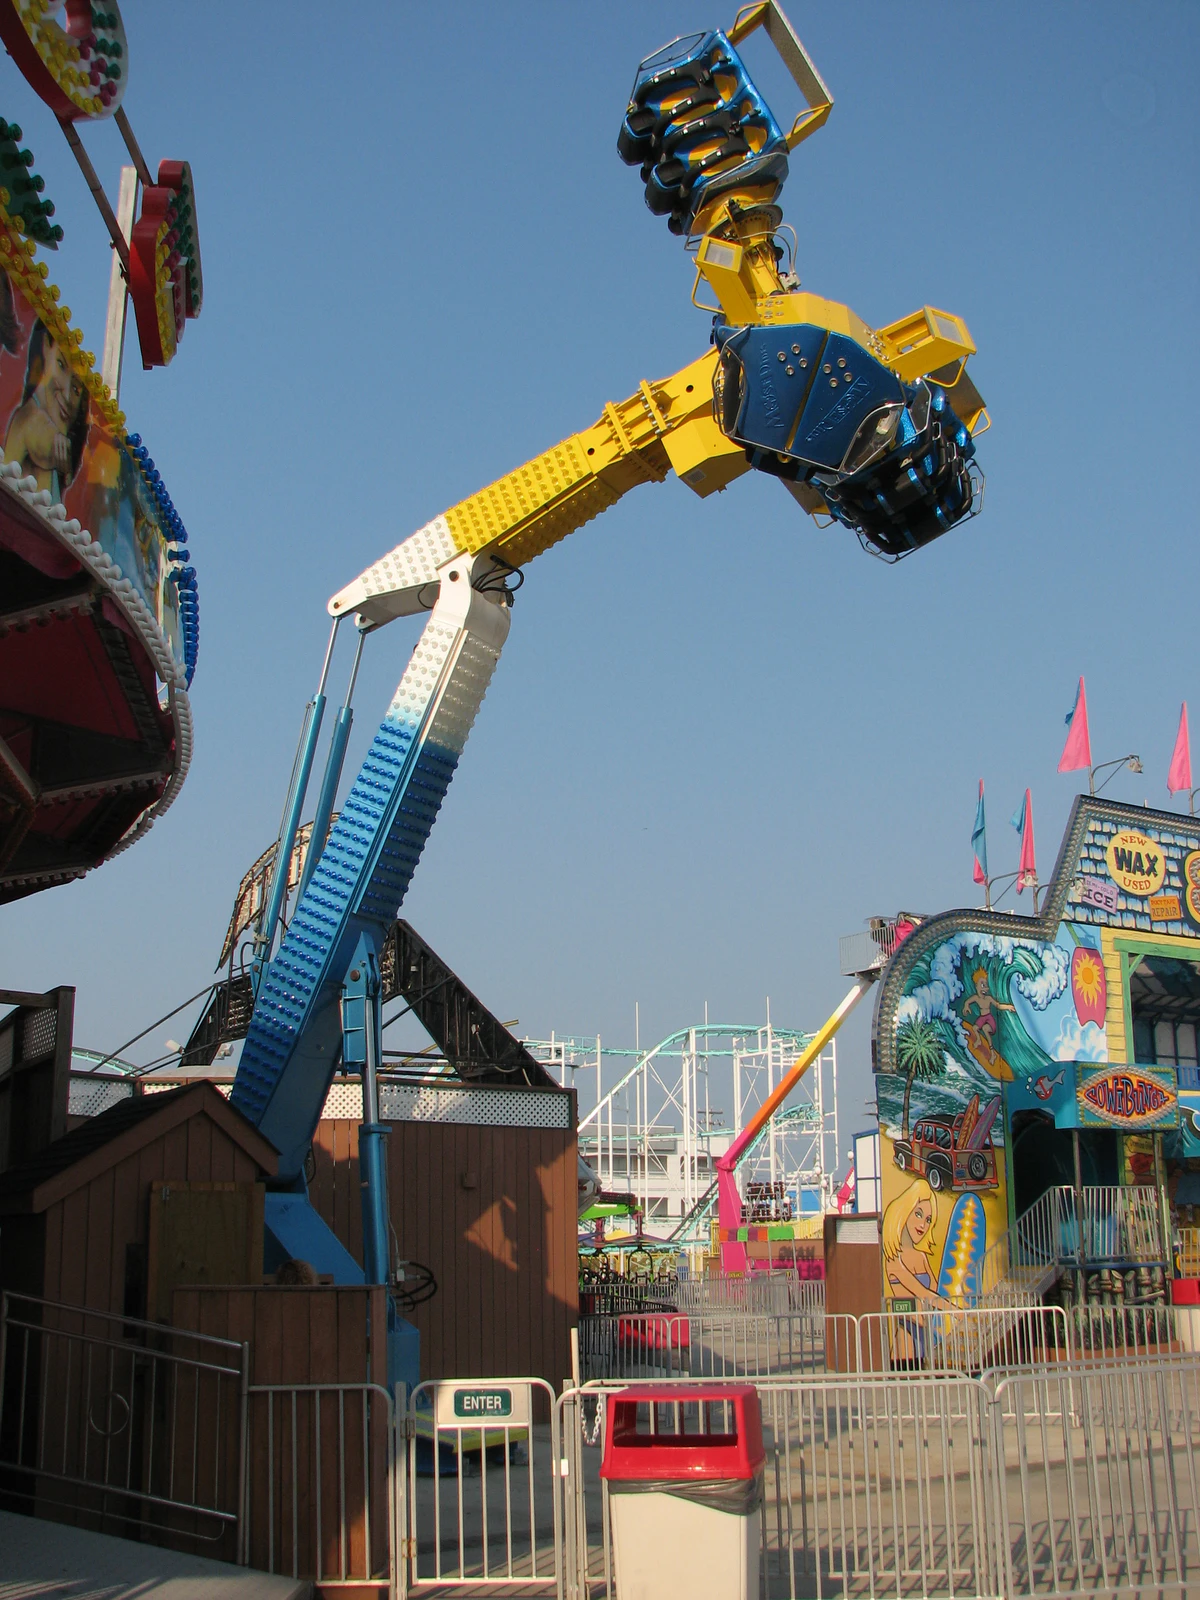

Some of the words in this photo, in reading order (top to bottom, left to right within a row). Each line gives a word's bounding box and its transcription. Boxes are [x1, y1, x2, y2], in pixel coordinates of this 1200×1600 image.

[1120, 835, 1147, 847] NEW
[1113, 846, 1159, 878] WAX
[1123, 877, 1151, 890] USED
[1084, 888, 1114, 909] ICE
[1151, 906, 1179, 918] REPAIR
[1084, 1076, 1170, 1118] COWABUNGA
[896, 1304, 908, 1312] EXIT
[463, 1395, 503, 1410] ENTER
